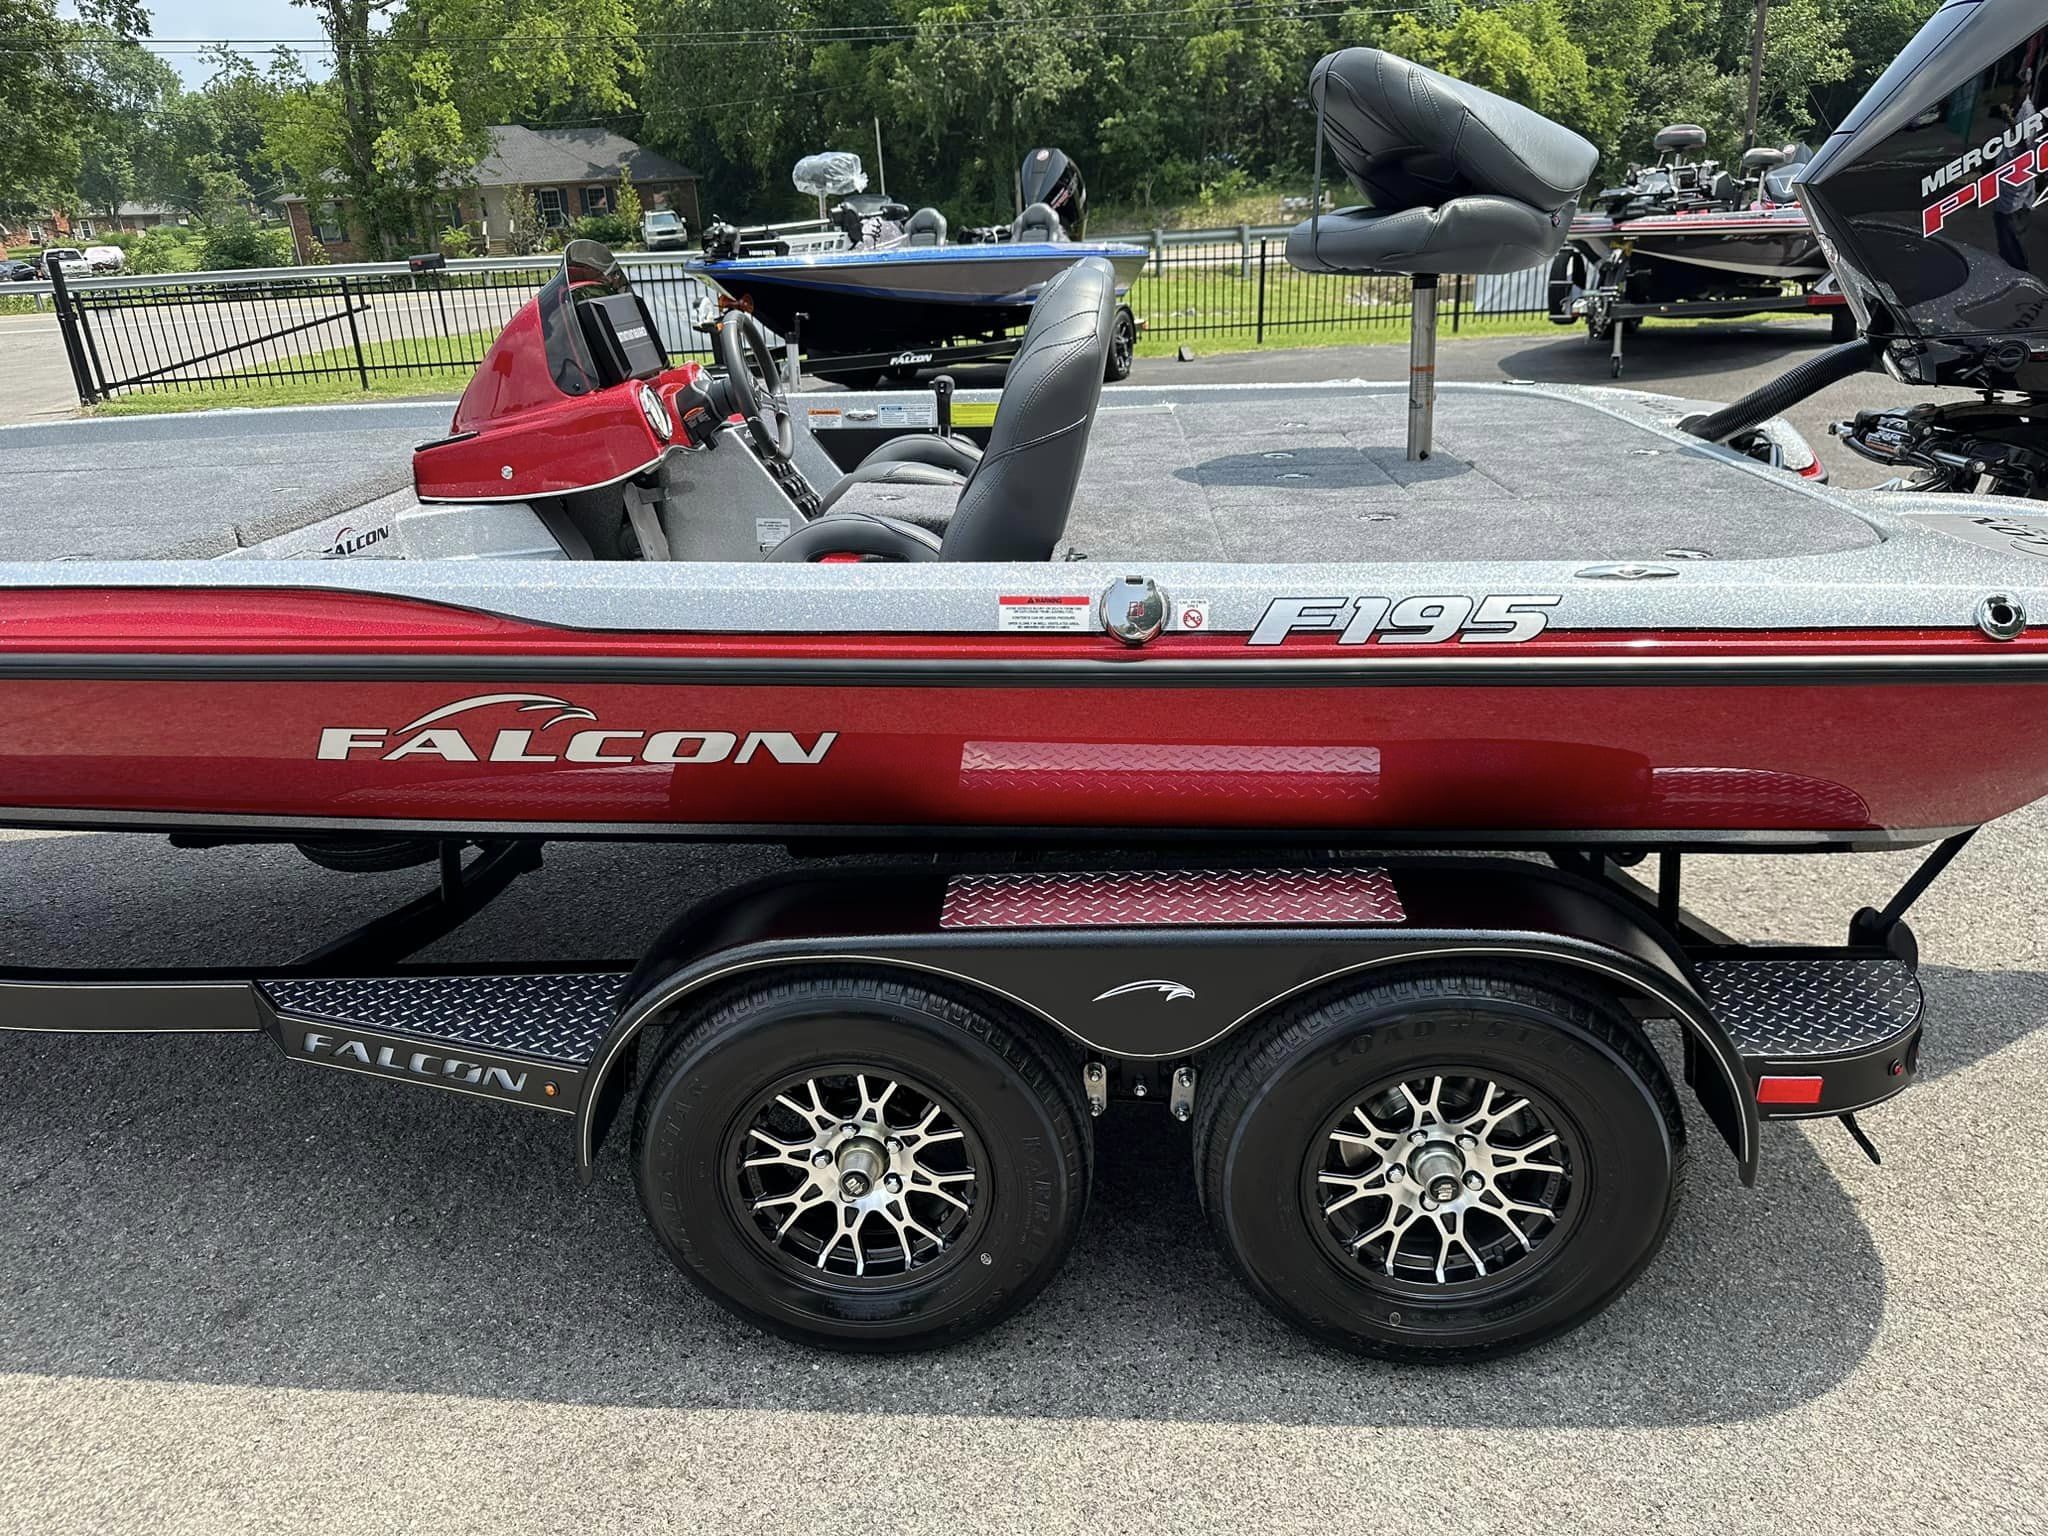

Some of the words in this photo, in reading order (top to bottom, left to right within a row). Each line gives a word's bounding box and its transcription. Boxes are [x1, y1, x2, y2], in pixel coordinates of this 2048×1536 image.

[1923, 140, 2048, 238] PR
[890, 352, 933, 366] FALCON
[1245, 594, 1563, 646] F195
[316, 727, 839, 764] FALCON
[302, 1032, 528, 1092] FALCON
